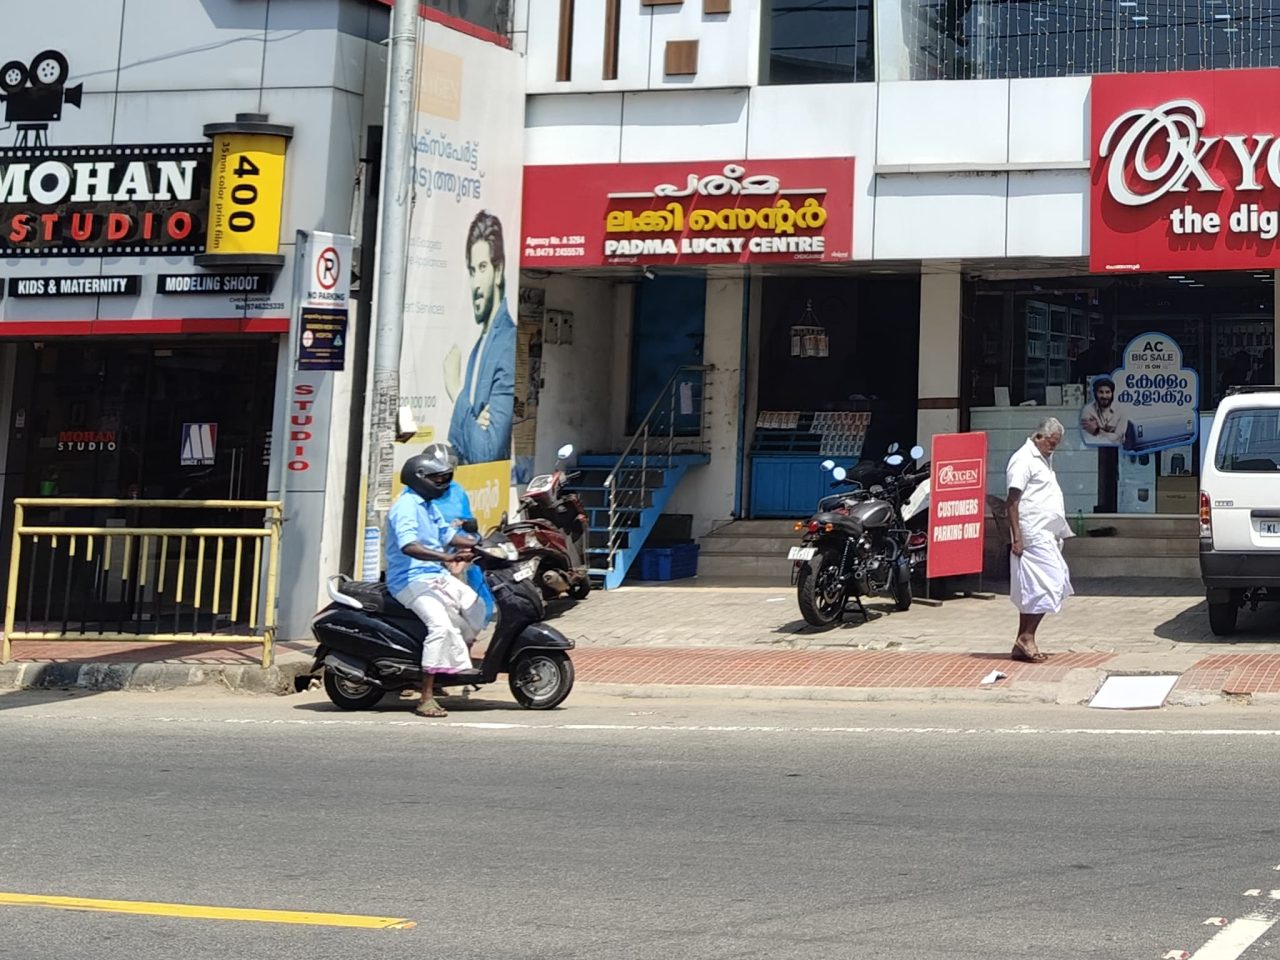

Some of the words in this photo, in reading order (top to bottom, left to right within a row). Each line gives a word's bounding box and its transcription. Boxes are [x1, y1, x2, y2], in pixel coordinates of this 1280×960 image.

[0, 160, 198, 206] MOHAN
[217, 175, 228, 200] color
[228, 154, 261, 233] 400
[215, 202, 225, 228] print
[1170, 204, 1221, 235] the
[10, 211, 193, 244] STUDIO
[212, 229, 224, 250] film
[604, 237, 678, 256] PADMA
[681, 236, 746, 254] LUCKY
[748, 235, 825, 253] CENTRE
[18, 278, 45, 296] KIDS
[47, 278, 57, 294] &
[60, 277, 128, 295] MATERNITY
[165, 275, 221, 291] MODELING
[223, 274, 260, 291] SHOOT
[307, 291, 317, 300] NO
[318, 291, 345, 301] PARKING
[1131, 353, 1148, 362] BIG
[1149, 353, 1174, 362] SALE
[1142, 341, 1164, 353] AC
[58, 431, 118, 443] MOHAN
[287, 384, 315, 472] STUDIO
[57, 441, 117, 452] STUDIO
[938, 464, 979, 485] OXYGEN
[937, 498, 979, 519] CUSTOMERS
[933, 523, 963, 544] PARKING
[963, 521, 981, 539] ONLY
